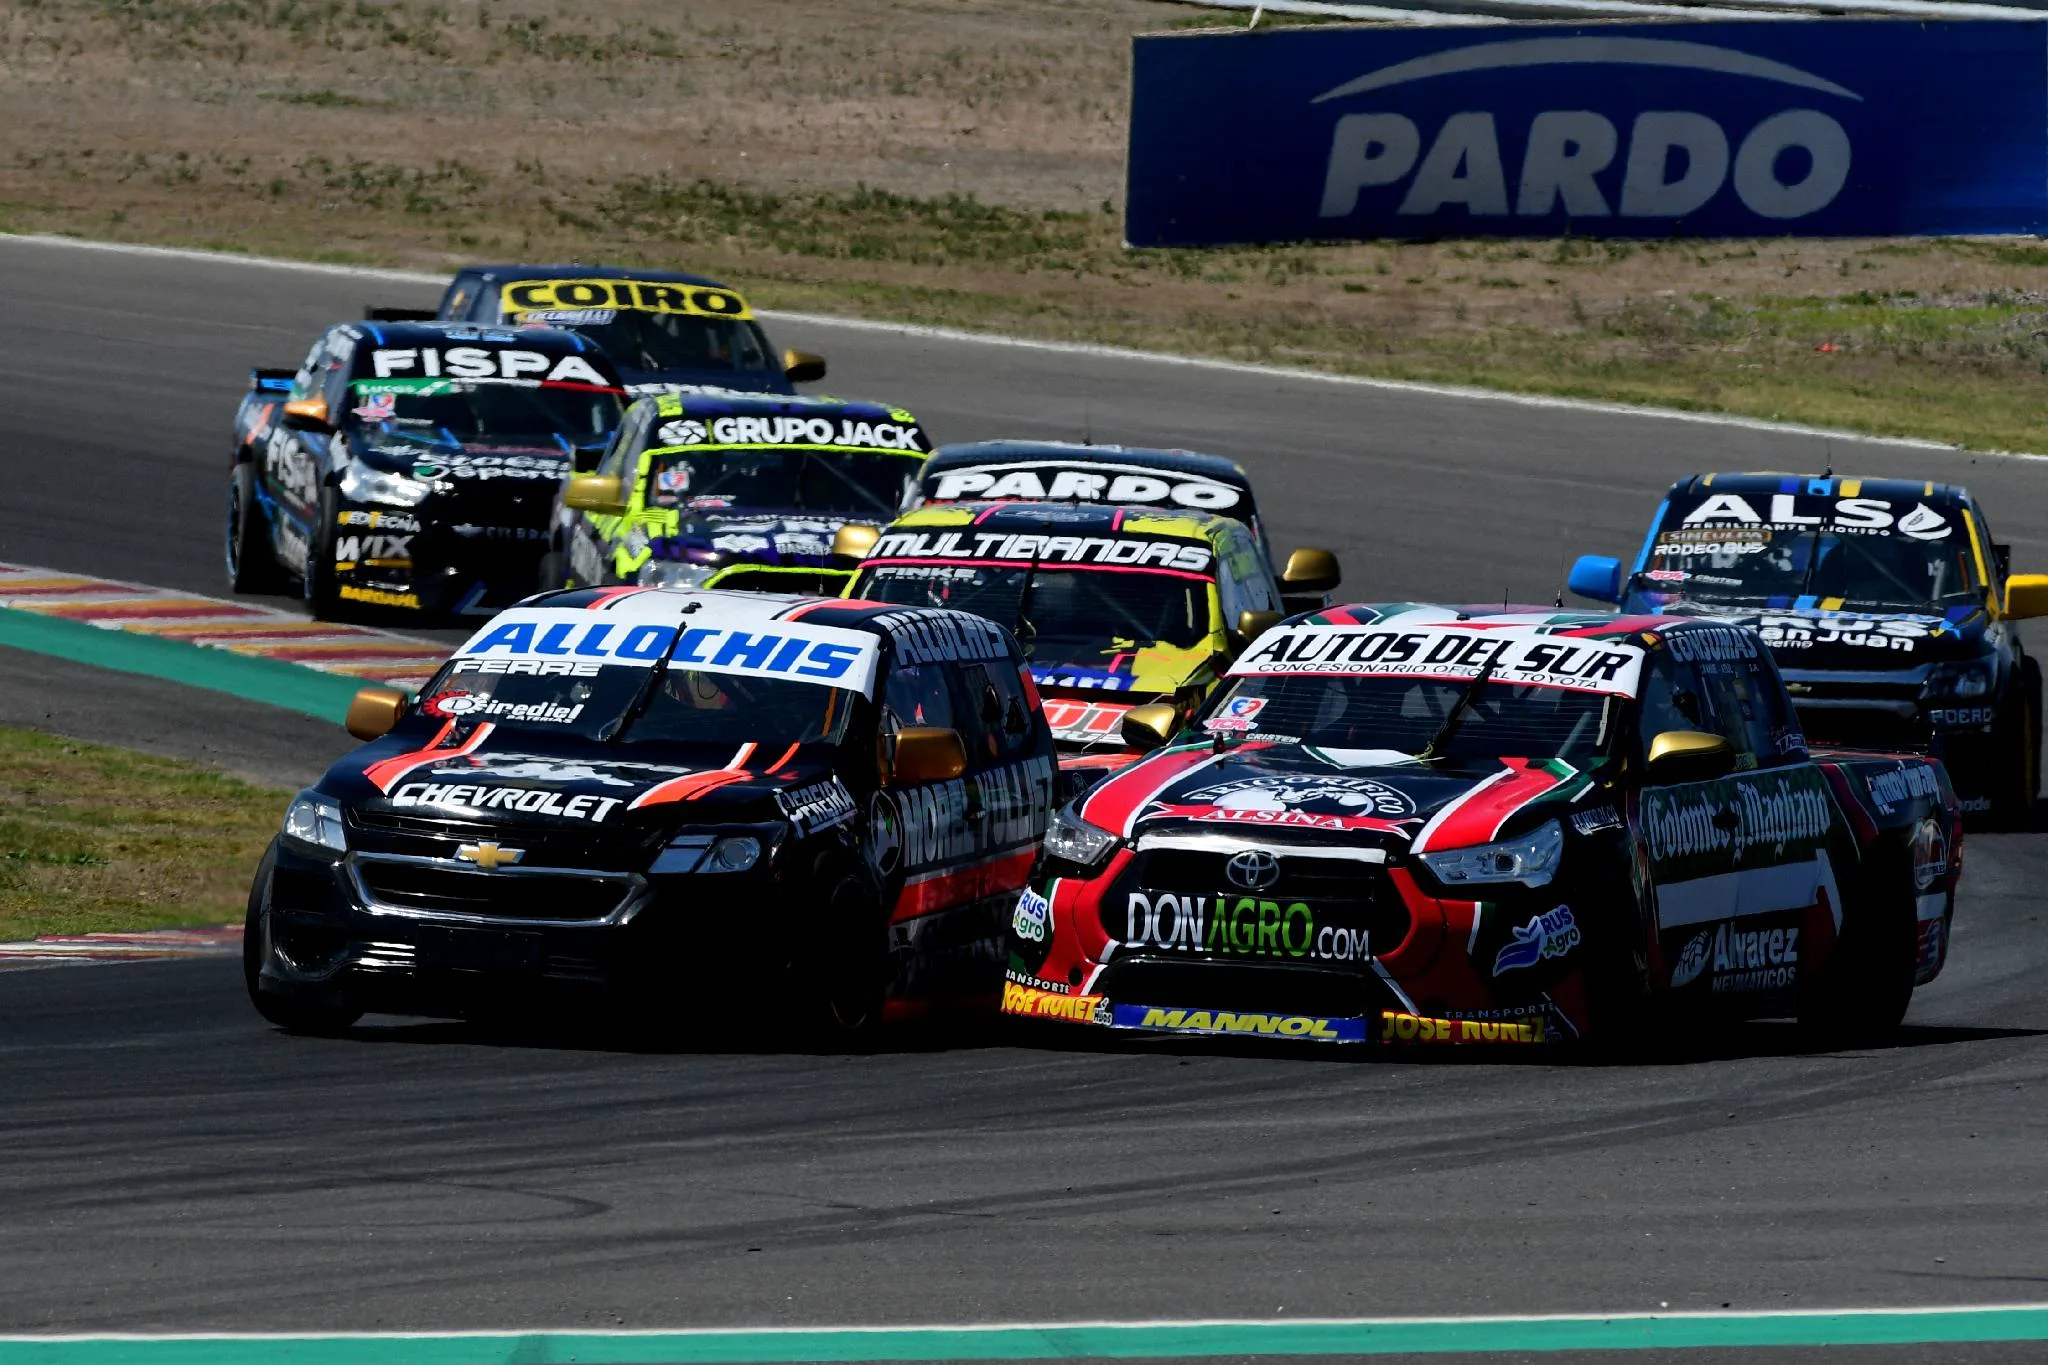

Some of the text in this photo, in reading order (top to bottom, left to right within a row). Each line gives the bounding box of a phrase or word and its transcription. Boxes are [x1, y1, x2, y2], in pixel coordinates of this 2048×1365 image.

[1318, 109, 1852, 219] PARDO
[510, 283, 743, 314] COIRO
[372, 347, 611, 386] FISPA
[934, 473, 1240, 508] PARDO
[1683, 494, 1895, 528] ALS
[336, 535, 414, 561] WIX
[868, 532, 1211, 571] MULTIBANDAS
[467, 621, 864, 679] ALLOCHIS
[1816, 630, 1915, 652] Juan
[453, 660, 602, 677] FERRE
[1245, 633, 1633, 681] AUTOS DEL SUR
[1259, 662, 1600, 689] CONCESIONARIO OFICAL TOYOTA
[1245, 733, 1302, 744] CRISTEN
[391, 782, 623, 822] CHEVROLET
[1204, 809, 1346, 829] ALSINA
[1020, 893, 1045, 920] RUS
[1540, 907, 1573, 936] RUS
[1714, 920, 1799, 974] Alvarez
[1144, 1008, 1338, 1037] MANNOL
[1381, 1011, 1451, 1041] JOSE
[1444, 1002, 1555, 1020] TRANSPORTE
